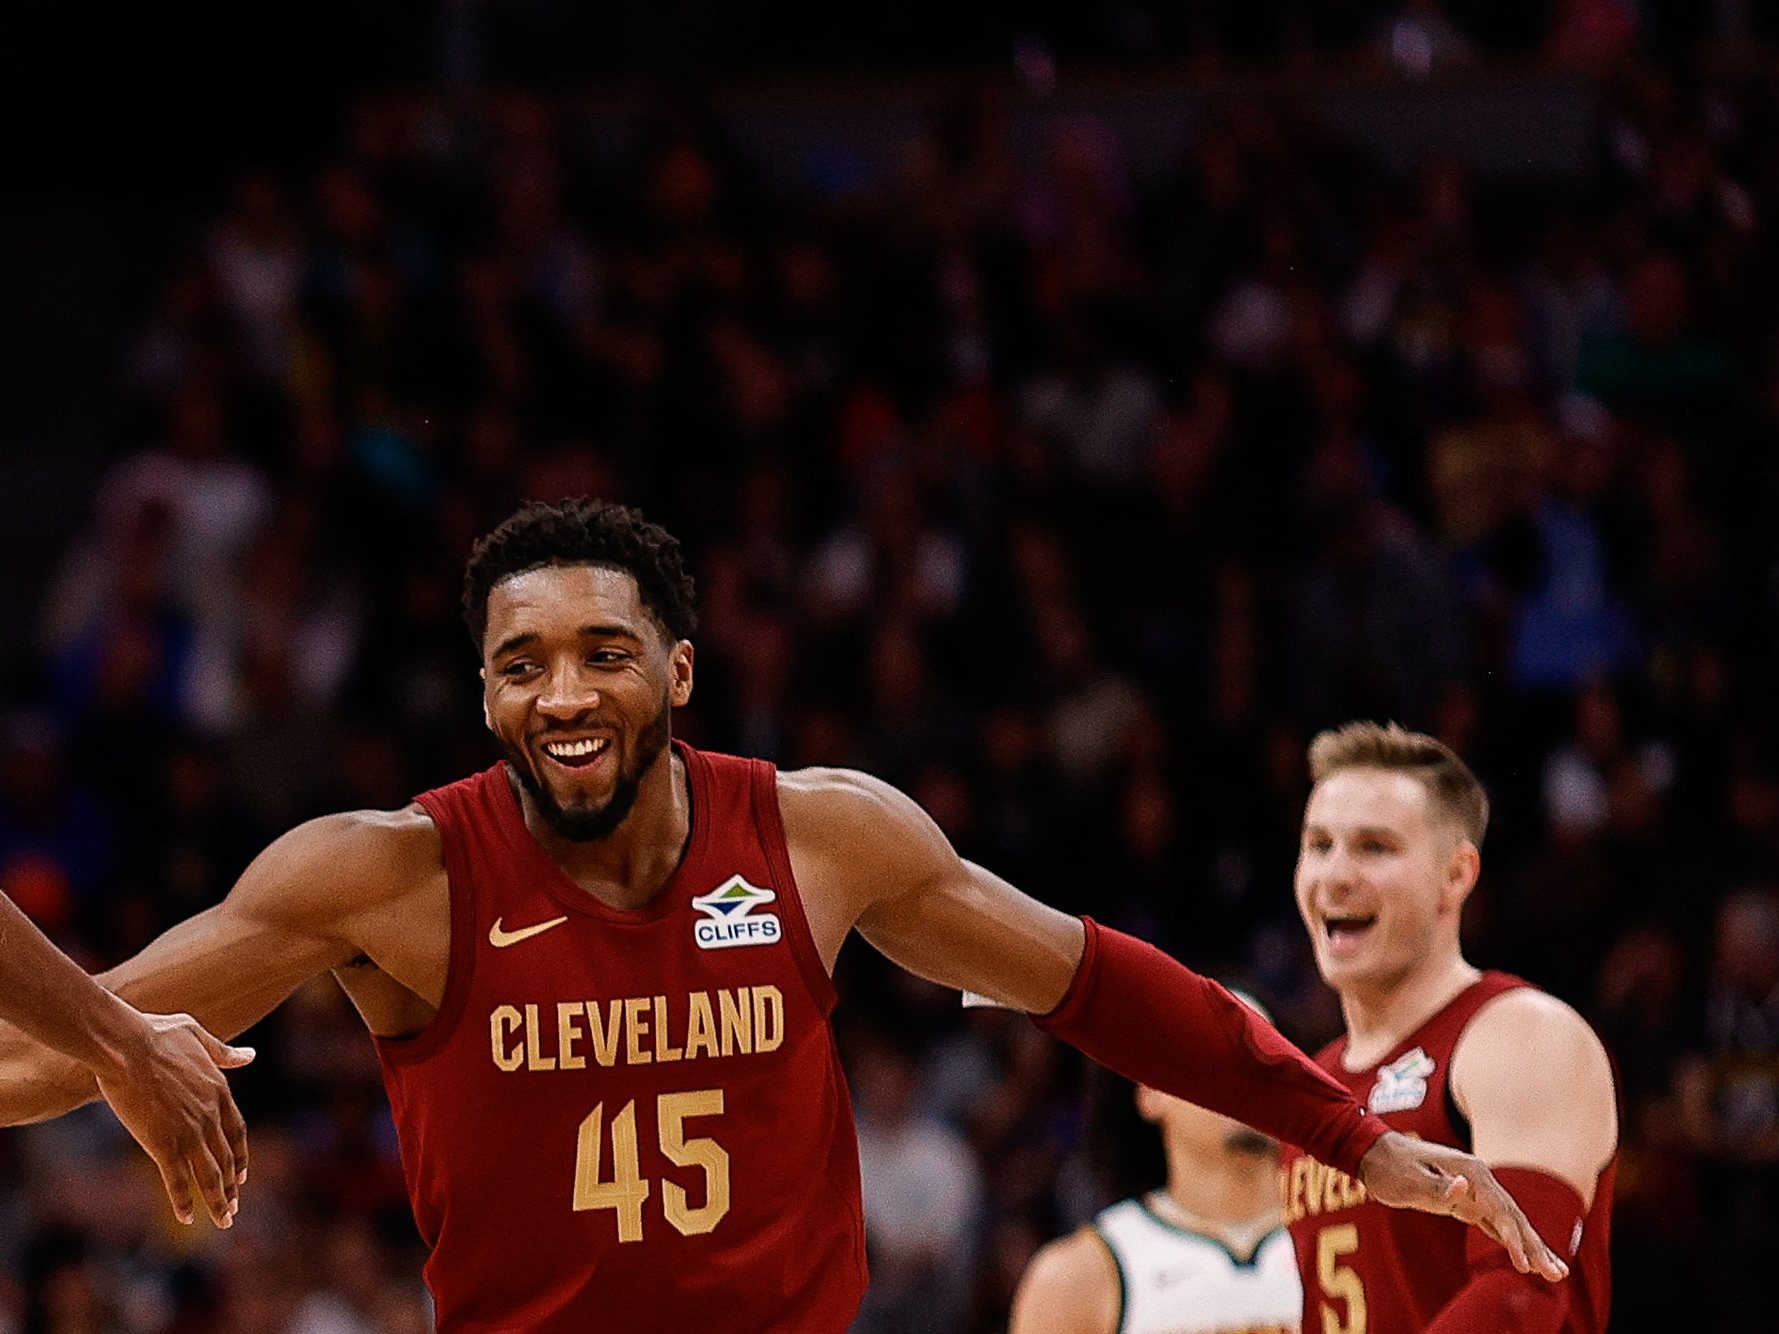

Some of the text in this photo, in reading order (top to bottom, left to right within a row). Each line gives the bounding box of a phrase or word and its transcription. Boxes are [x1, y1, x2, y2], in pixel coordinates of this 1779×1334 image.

[698, 921, 777, 942] CLIFFS
[489, 984, 784, 1072] CLEVELAND
[572, 1089, 730, 1243] 45
